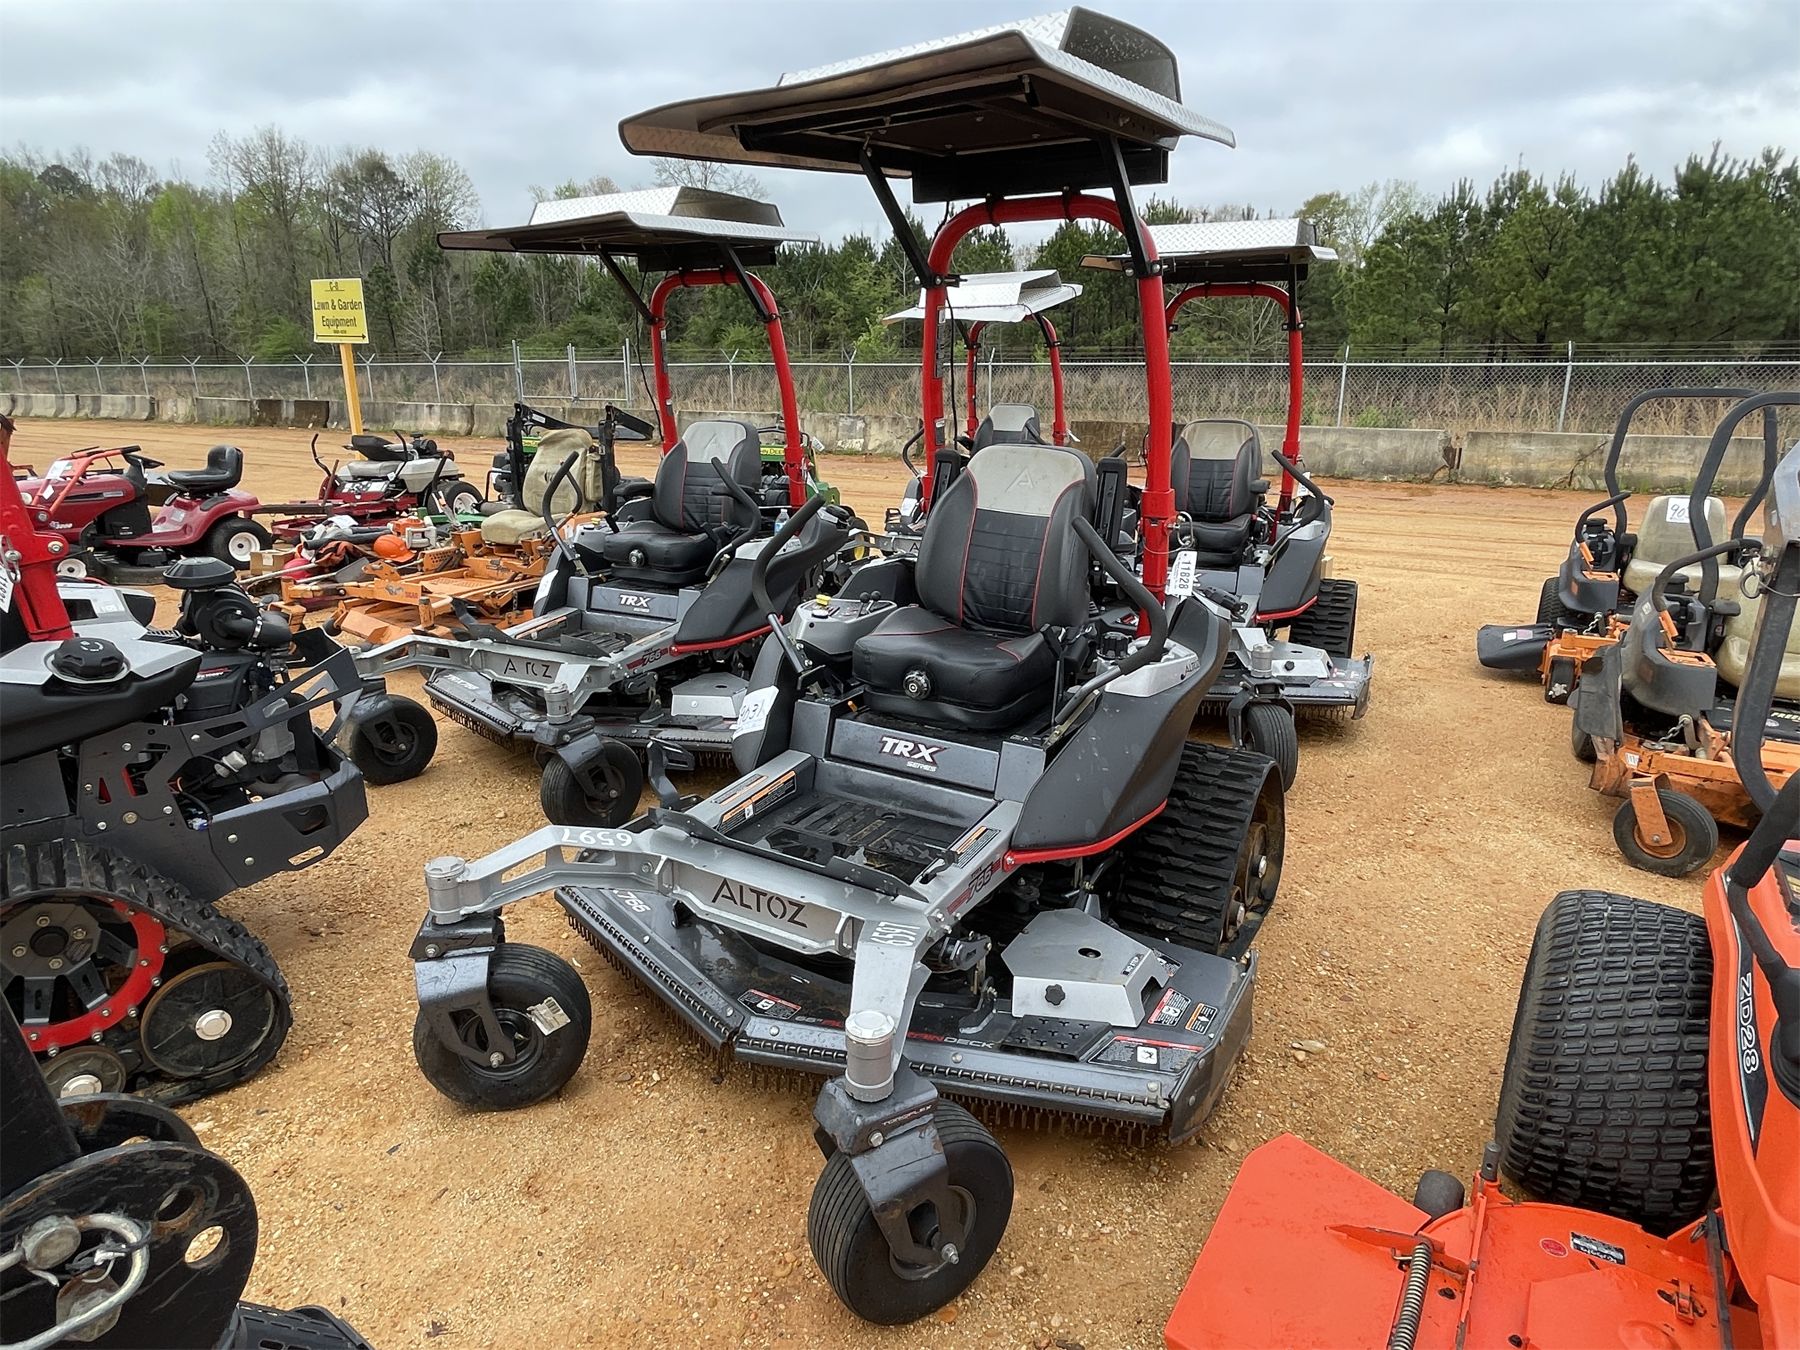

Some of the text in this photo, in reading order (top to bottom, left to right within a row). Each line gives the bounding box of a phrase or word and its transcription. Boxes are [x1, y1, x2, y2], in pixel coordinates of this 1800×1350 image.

[314, 299, 363, 310] Lawn & Garden
[322, 316, 357, 329] Equipment
[1179, 561, 1191, 590] 11828
[620, 594, 651, 608] TRX
[880, 736, 942, 763] TRX
[906, 761, 937, 772] SERIES
[711, 878, 808, 929] ALTOZ
[1740, 972, 1759, 1074] ZD28
